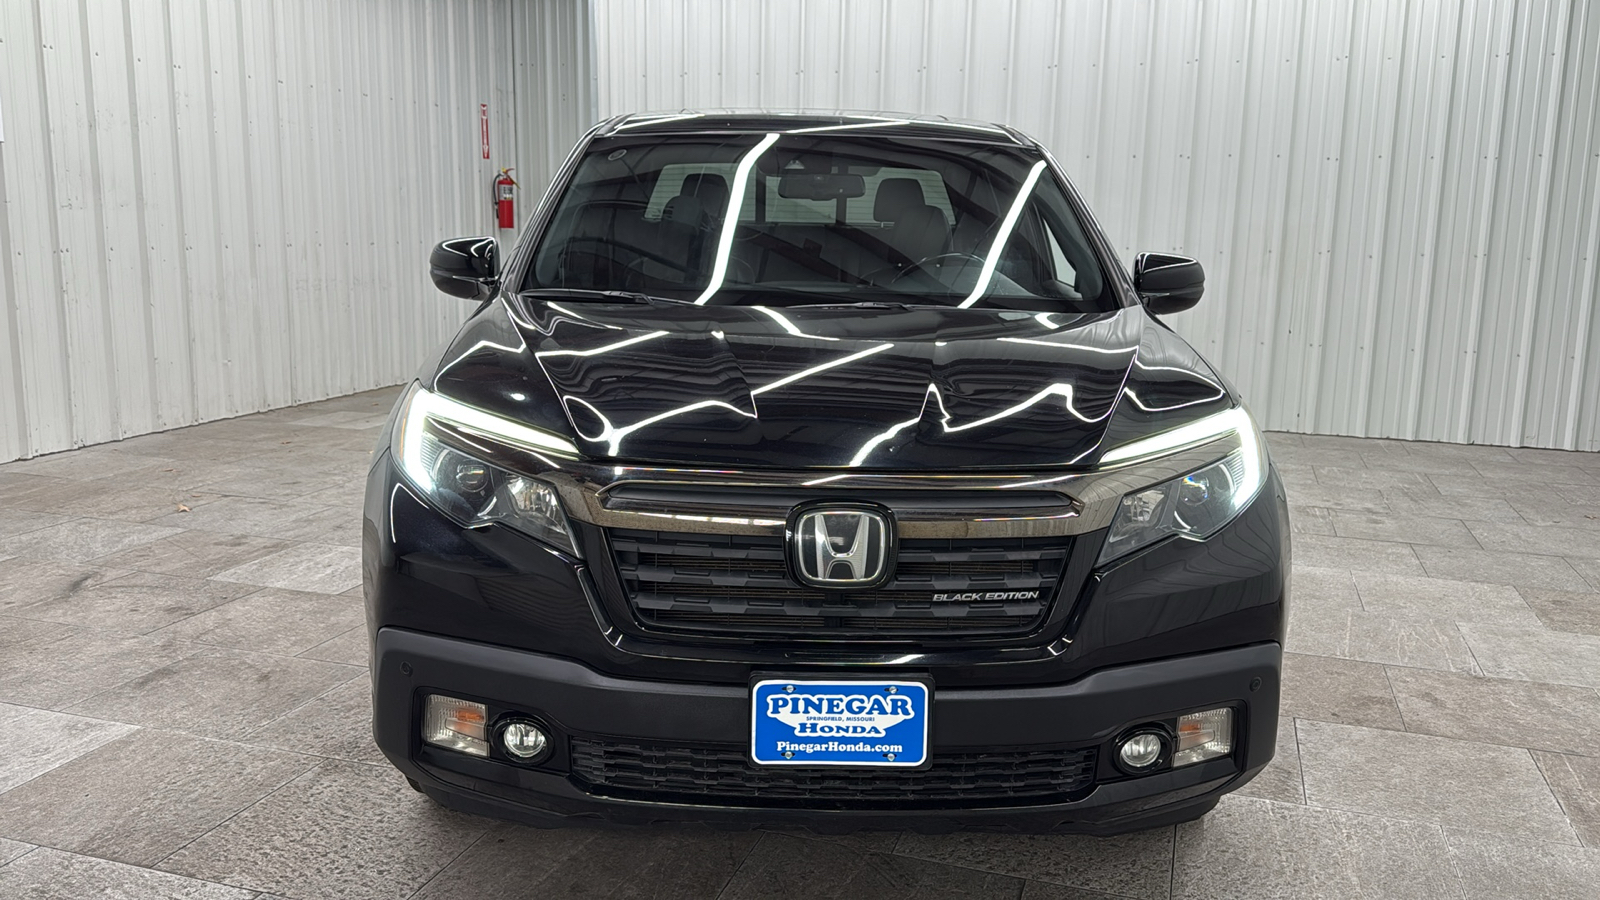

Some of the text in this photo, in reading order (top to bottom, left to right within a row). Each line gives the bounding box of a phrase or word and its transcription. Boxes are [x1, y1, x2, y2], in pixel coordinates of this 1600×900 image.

[932, 591, 1040, 602] BLACK EDITION
[769, 697, 912, 716] PINEGAR
[798, 723, 882, 735] HONDA
[776, 741, 903, 753] PinegarHonda.com
